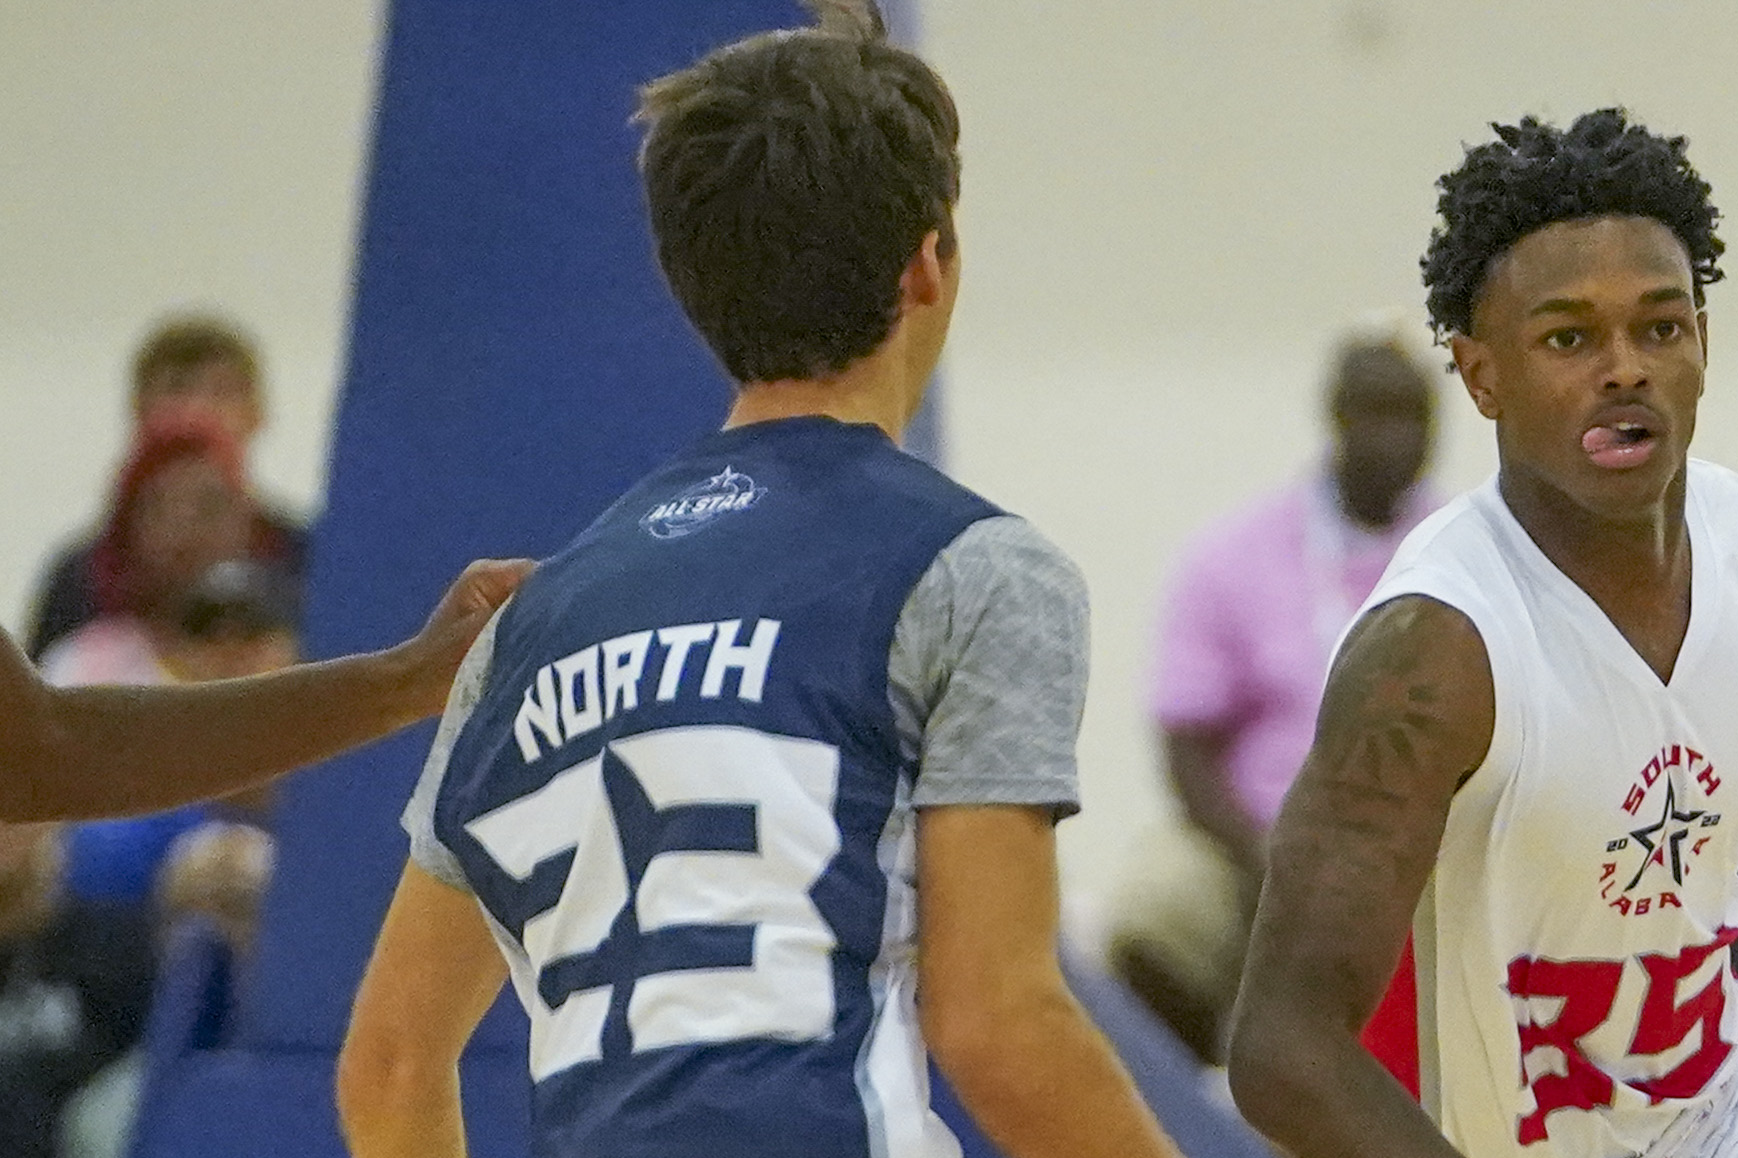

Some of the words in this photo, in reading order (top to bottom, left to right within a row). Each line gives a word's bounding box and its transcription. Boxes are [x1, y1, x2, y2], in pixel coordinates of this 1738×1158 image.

[513, 618, 782, 763] NORTH
[1620, 743, 1722, 817] SOUTH
[1606, 837, 1629, 853] 20
[464, 725, 840, 1084] 23
